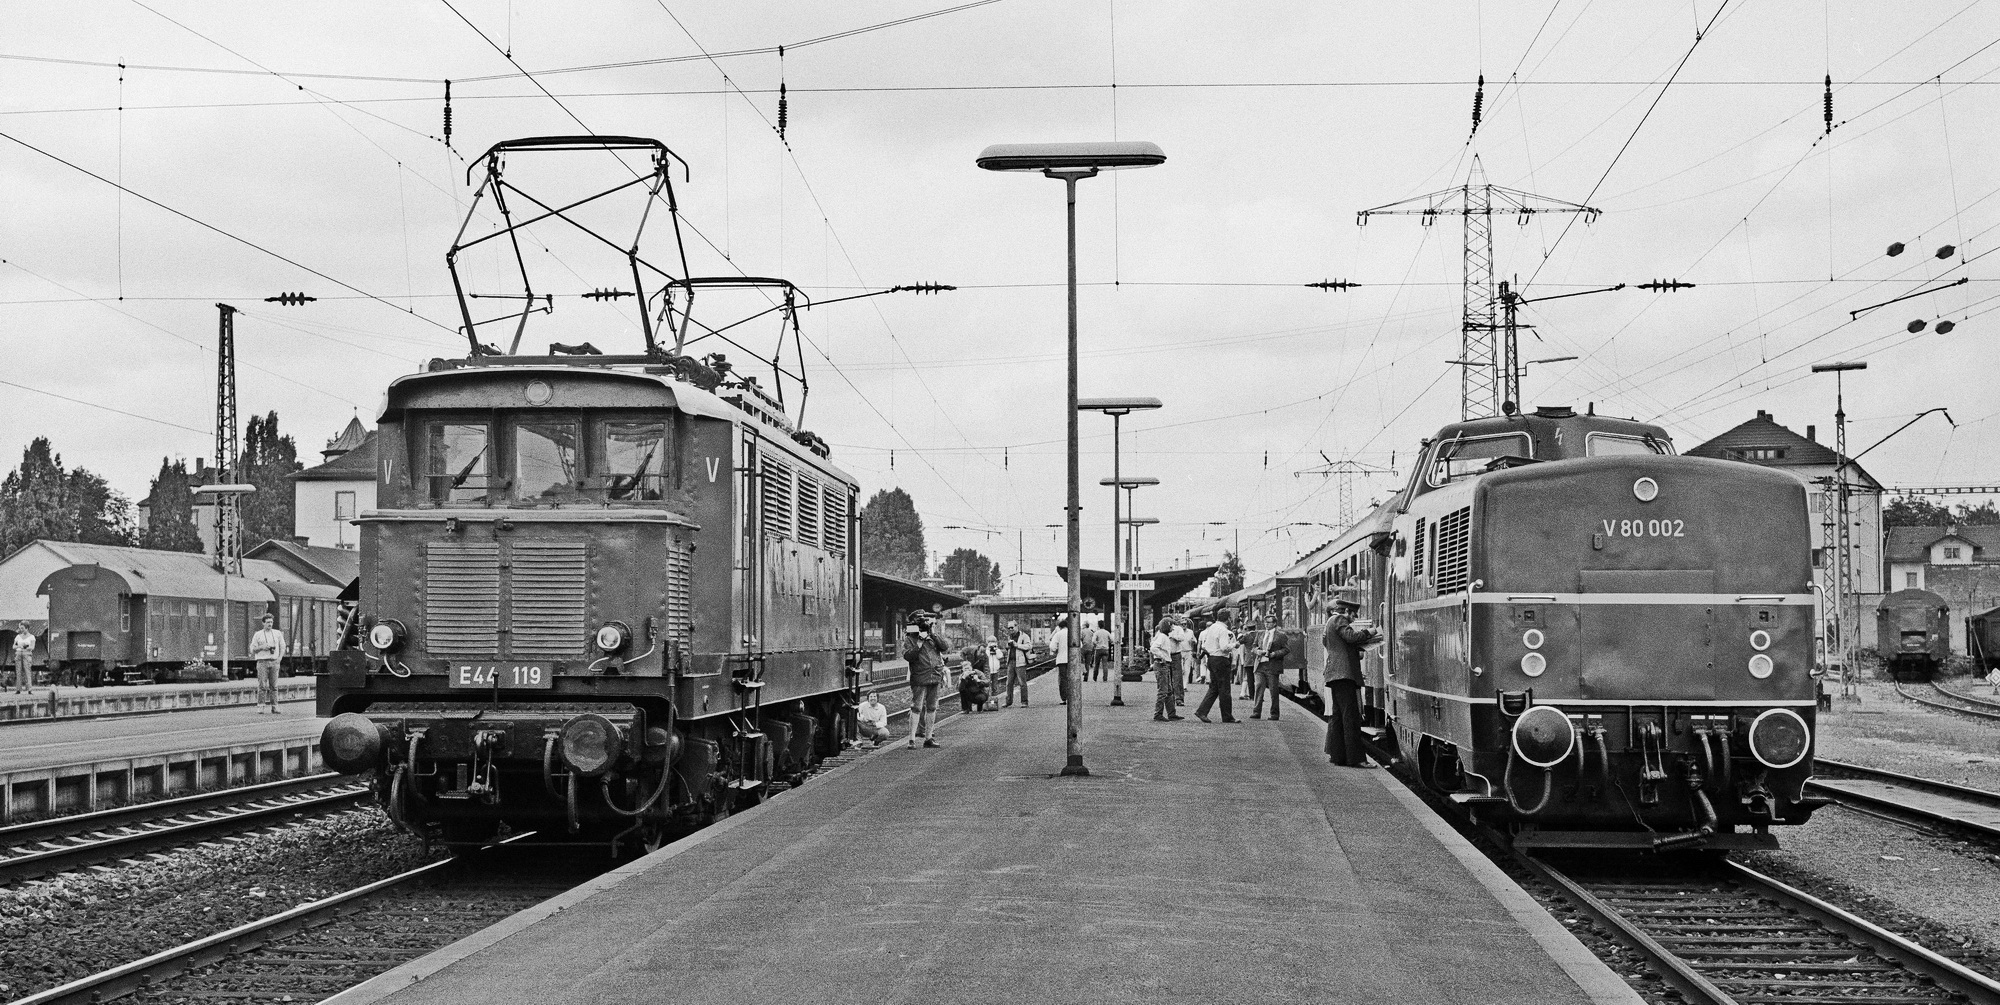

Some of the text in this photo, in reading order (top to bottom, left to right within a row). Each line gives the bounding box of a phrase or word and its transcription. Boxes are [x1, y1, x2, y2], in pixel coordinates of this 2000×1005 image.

[384, 459, 393, 484] V
[705, 456, 720, 482] V
[1602, 519, 1685, 537] V 80 002
[512, 666, 541, 684] 119
